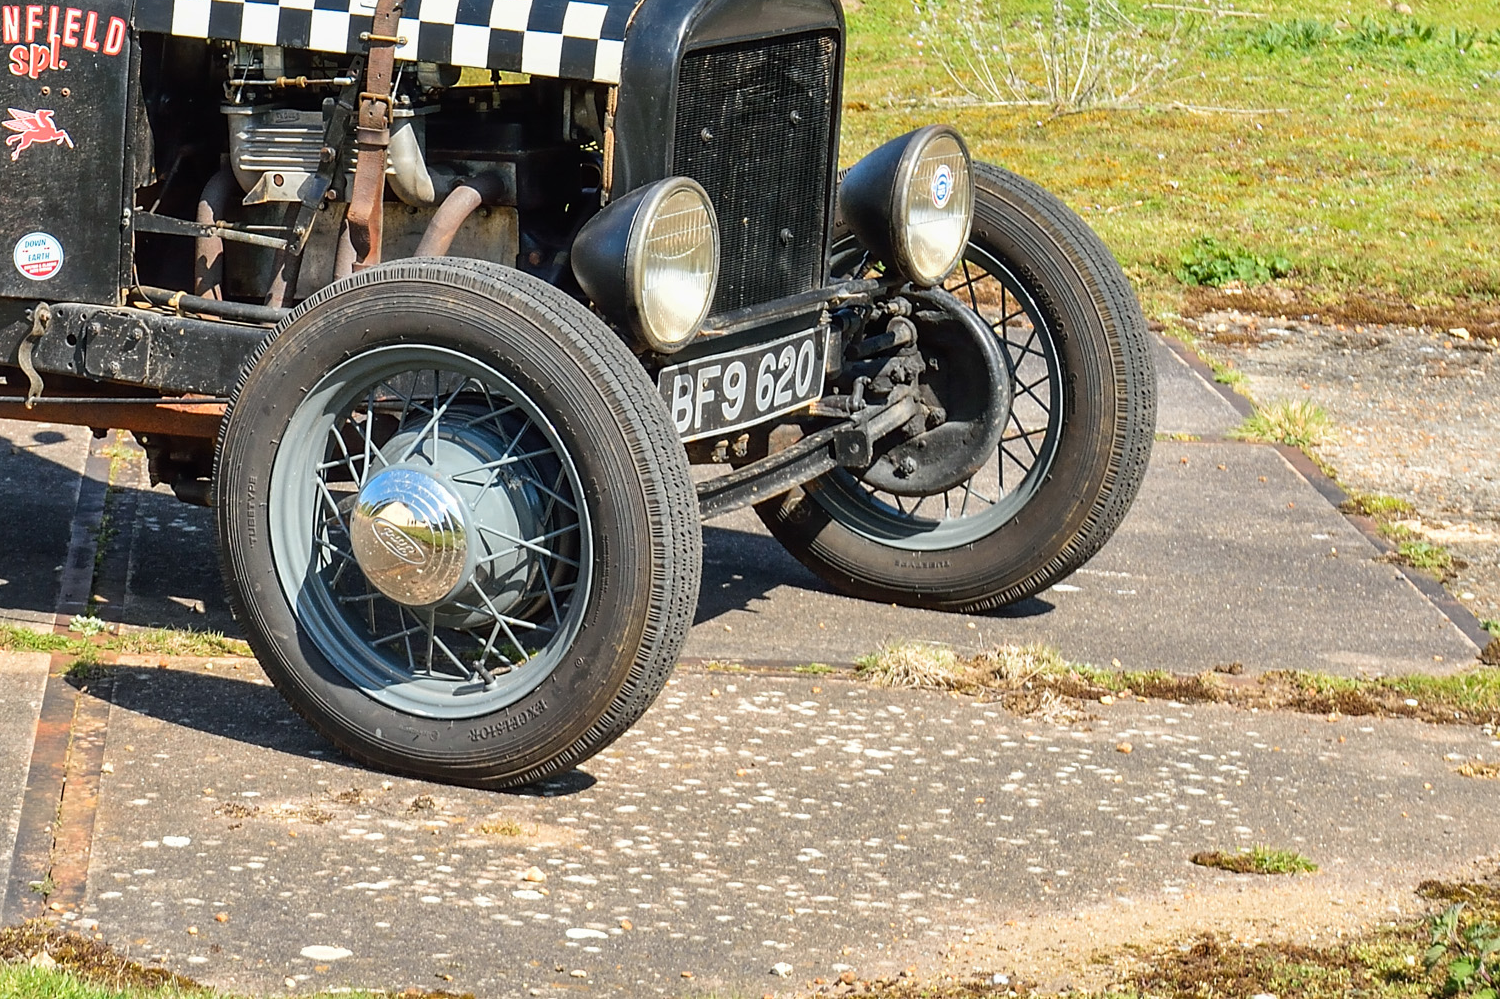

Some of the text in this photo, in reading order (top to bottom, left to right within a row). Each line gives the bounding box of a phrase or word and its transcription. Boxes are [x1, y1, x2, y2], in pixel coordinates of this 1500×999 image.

[8, 33, 68, 79] spl.
[24, 238, 47, 248] DOWN
[28, 252, 50, 262] EARTH
[1020, 263, 1069, 341] EXCELSIOR
[671, 339, 815, 433] BF9 620
[245, 476, 258, 542] TUBETYPE
[379, 526, 417, 557] Ford
[467, 698, 548, 742] EXCELSIOR
